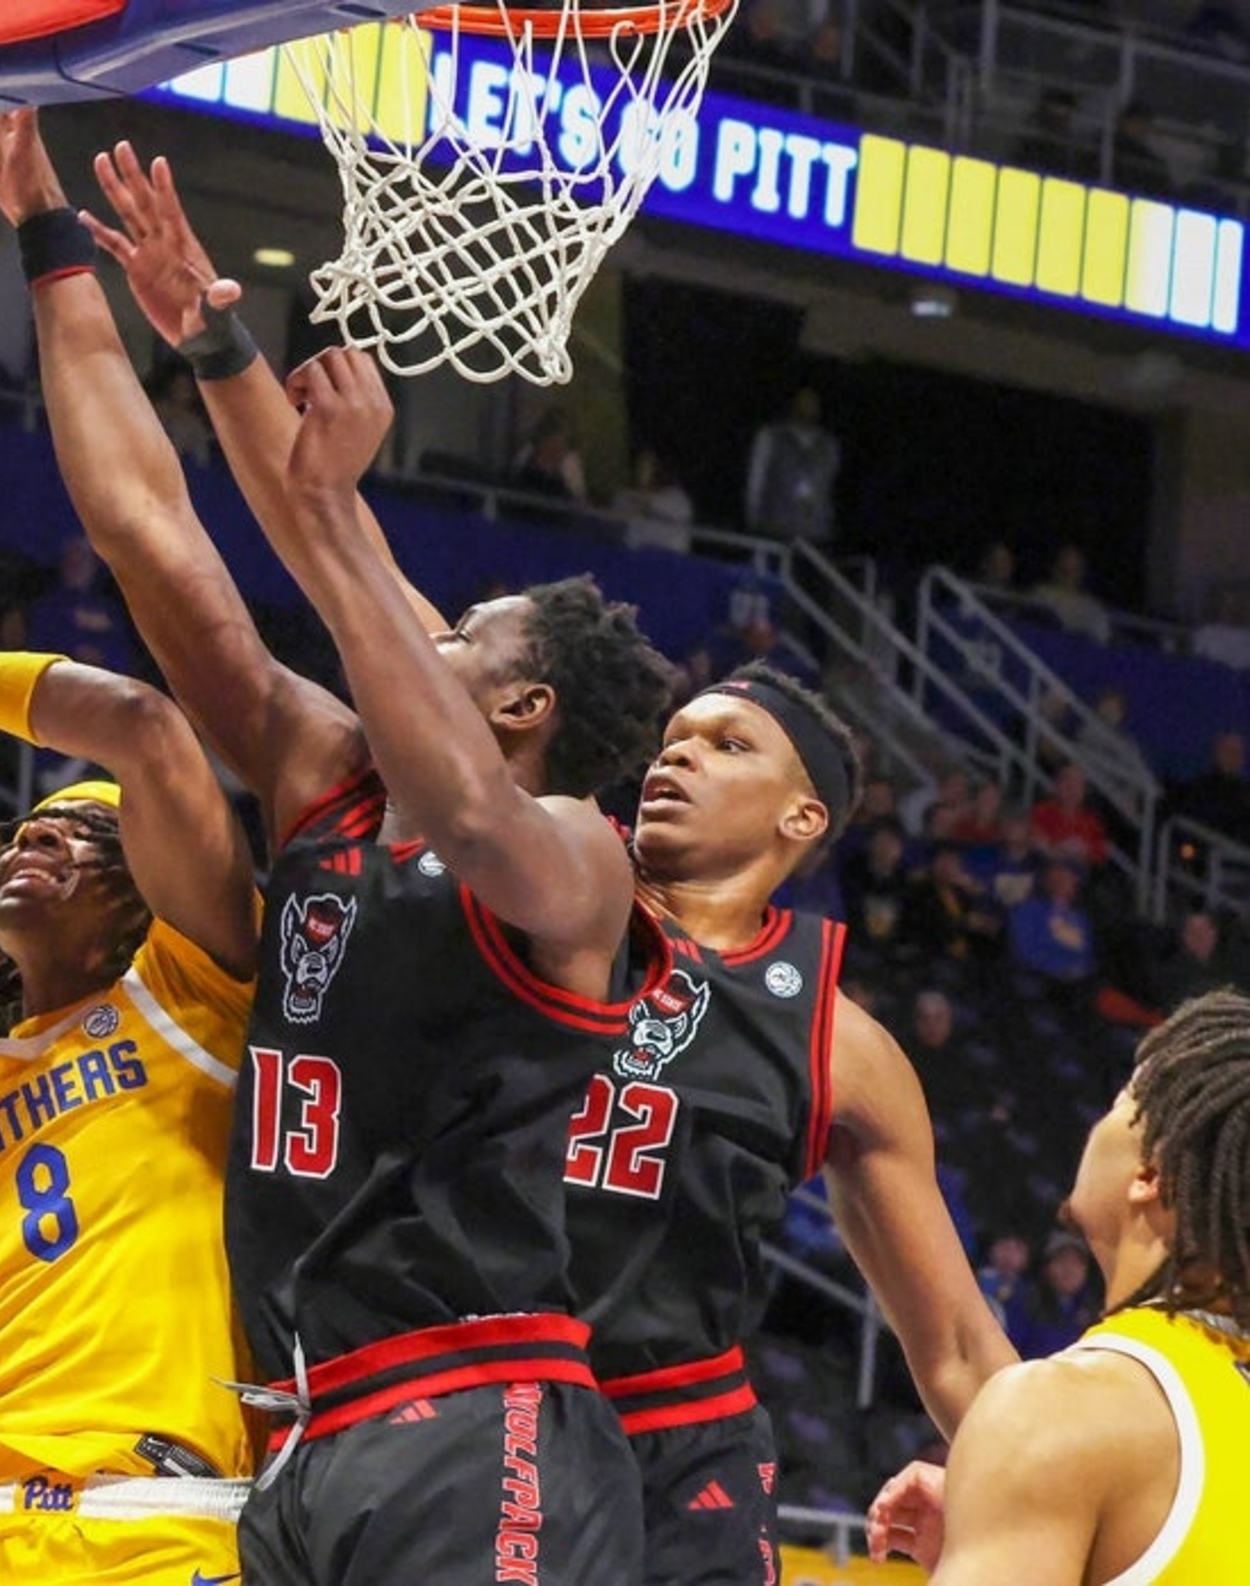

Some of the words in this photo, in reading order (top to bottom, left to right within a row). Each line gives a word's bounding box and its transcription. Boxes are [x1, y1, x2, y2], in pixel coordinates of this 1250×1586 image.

[428, 51, 602, 168] LET'S
[617, 99, 700, 191] GO
[712, 118, 859, 227] PITT
[249, 1045, 343, 1180] 13
[563, 1074, 679, 1200] 22
[16, 1142, 79, 1263] 8
[22, 1475, 75, 1511] Pitt
[495, 1381, 543, 1586] WOLFPACK
